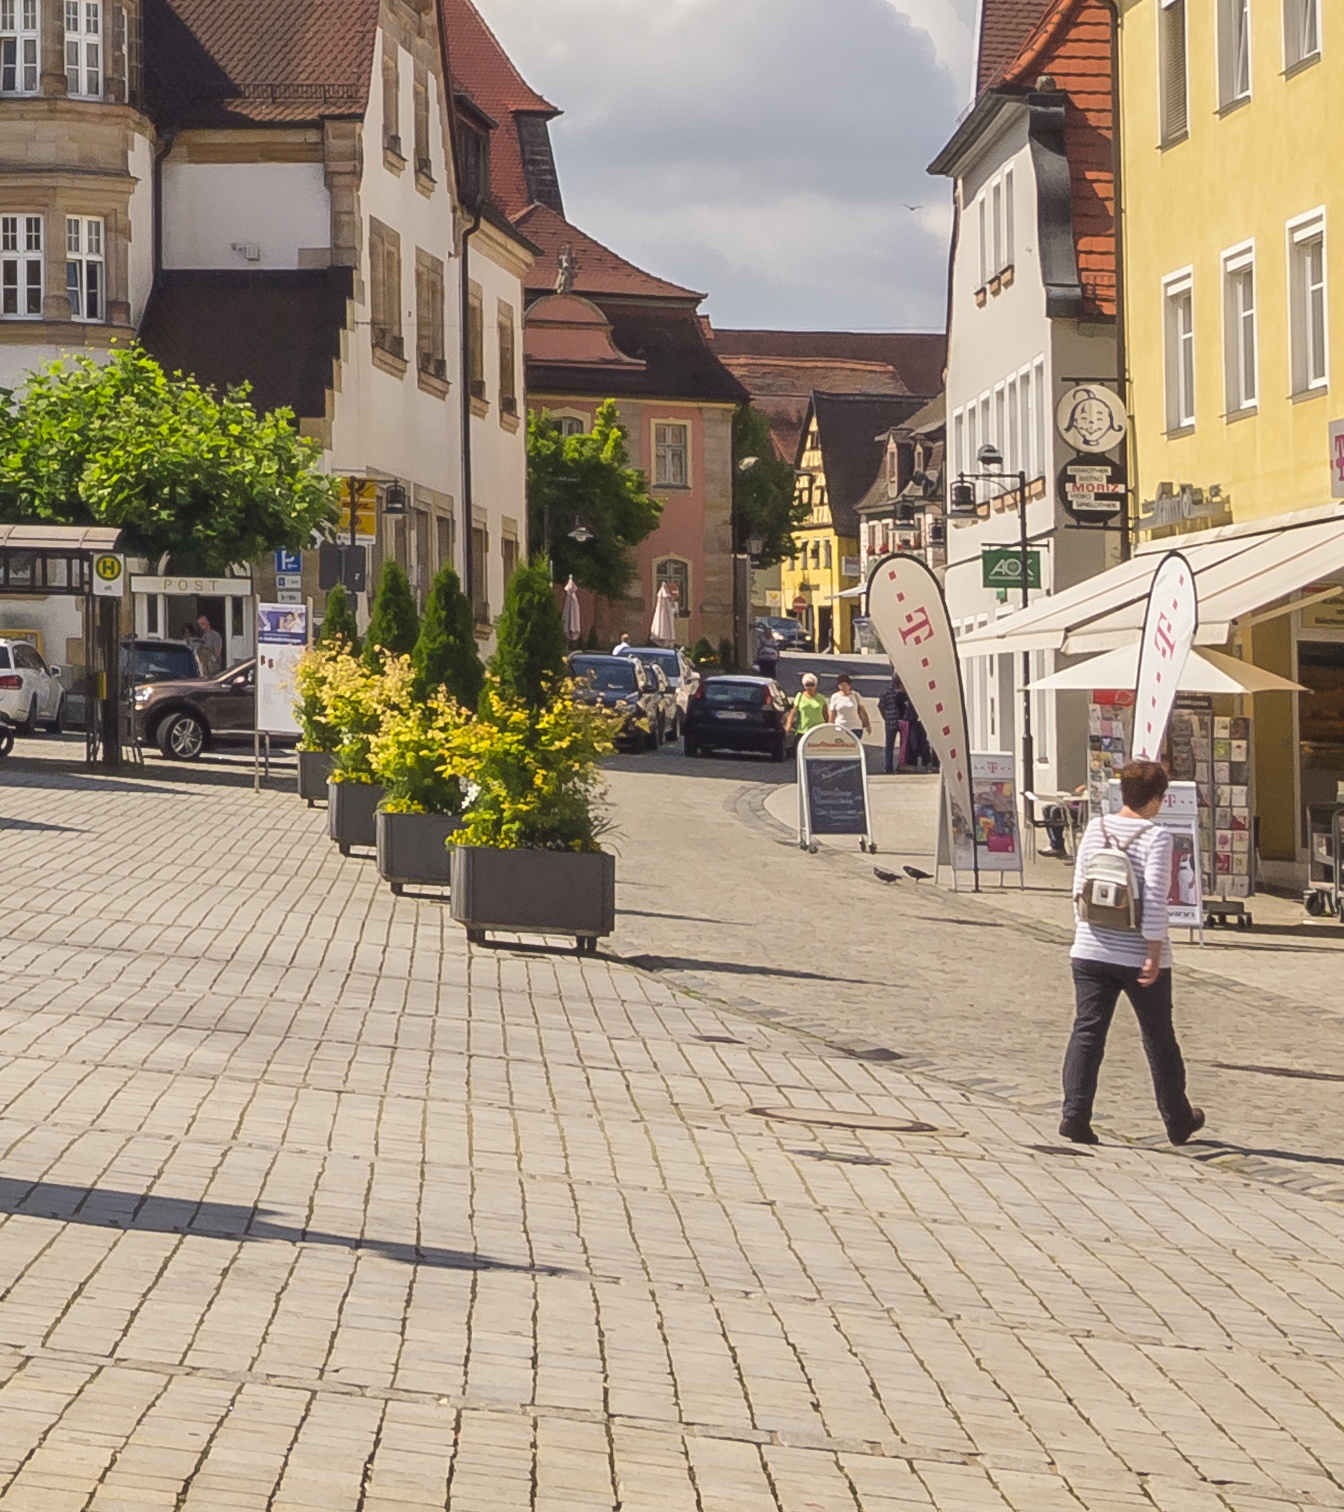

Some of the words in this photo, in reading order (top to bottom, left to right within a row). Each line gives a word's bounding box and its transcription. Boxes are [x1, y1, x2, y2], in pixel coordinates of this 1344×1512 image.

[1072, 483, 1119, 493] MORIZ
[103, 560, 114, 575] H
[164, 579, 219, 592] POST
